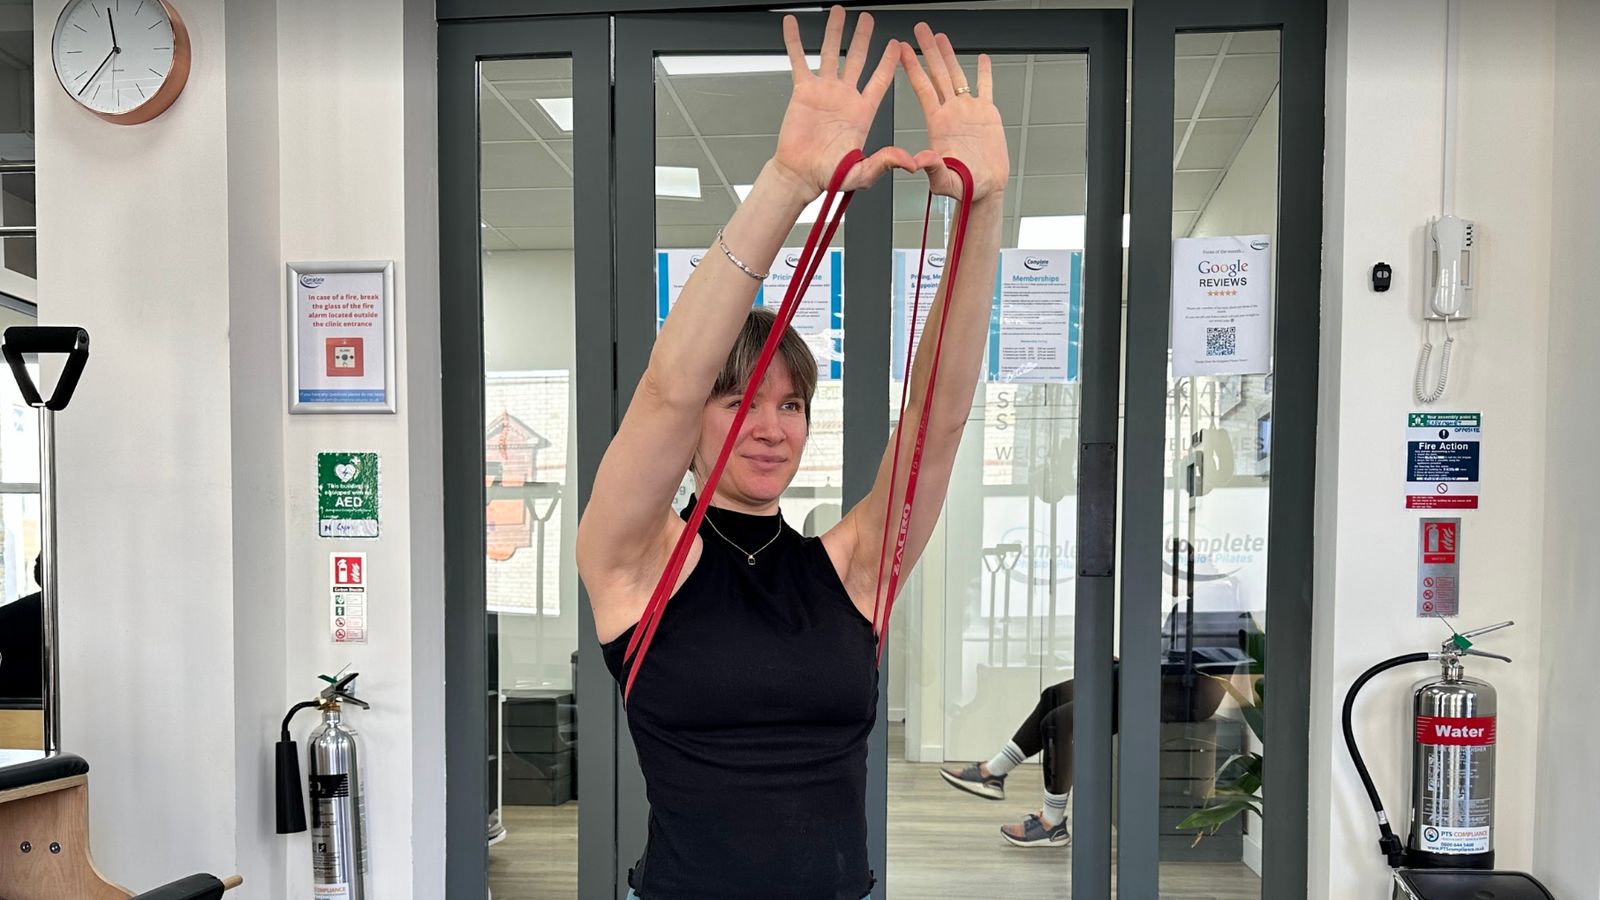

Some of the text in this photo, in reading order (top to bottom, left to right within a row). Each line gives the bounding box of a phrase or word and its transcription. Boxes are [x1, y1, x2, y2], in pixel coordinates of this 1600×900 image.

[1198, 259, 1248, 278] Google
[1199, 277, 1247, 287] REVIEWS
[335, 497, 362, 507] AED
[892, 503, 911, 576] ZACRO
[1435, 725, 1484, 737] Water
